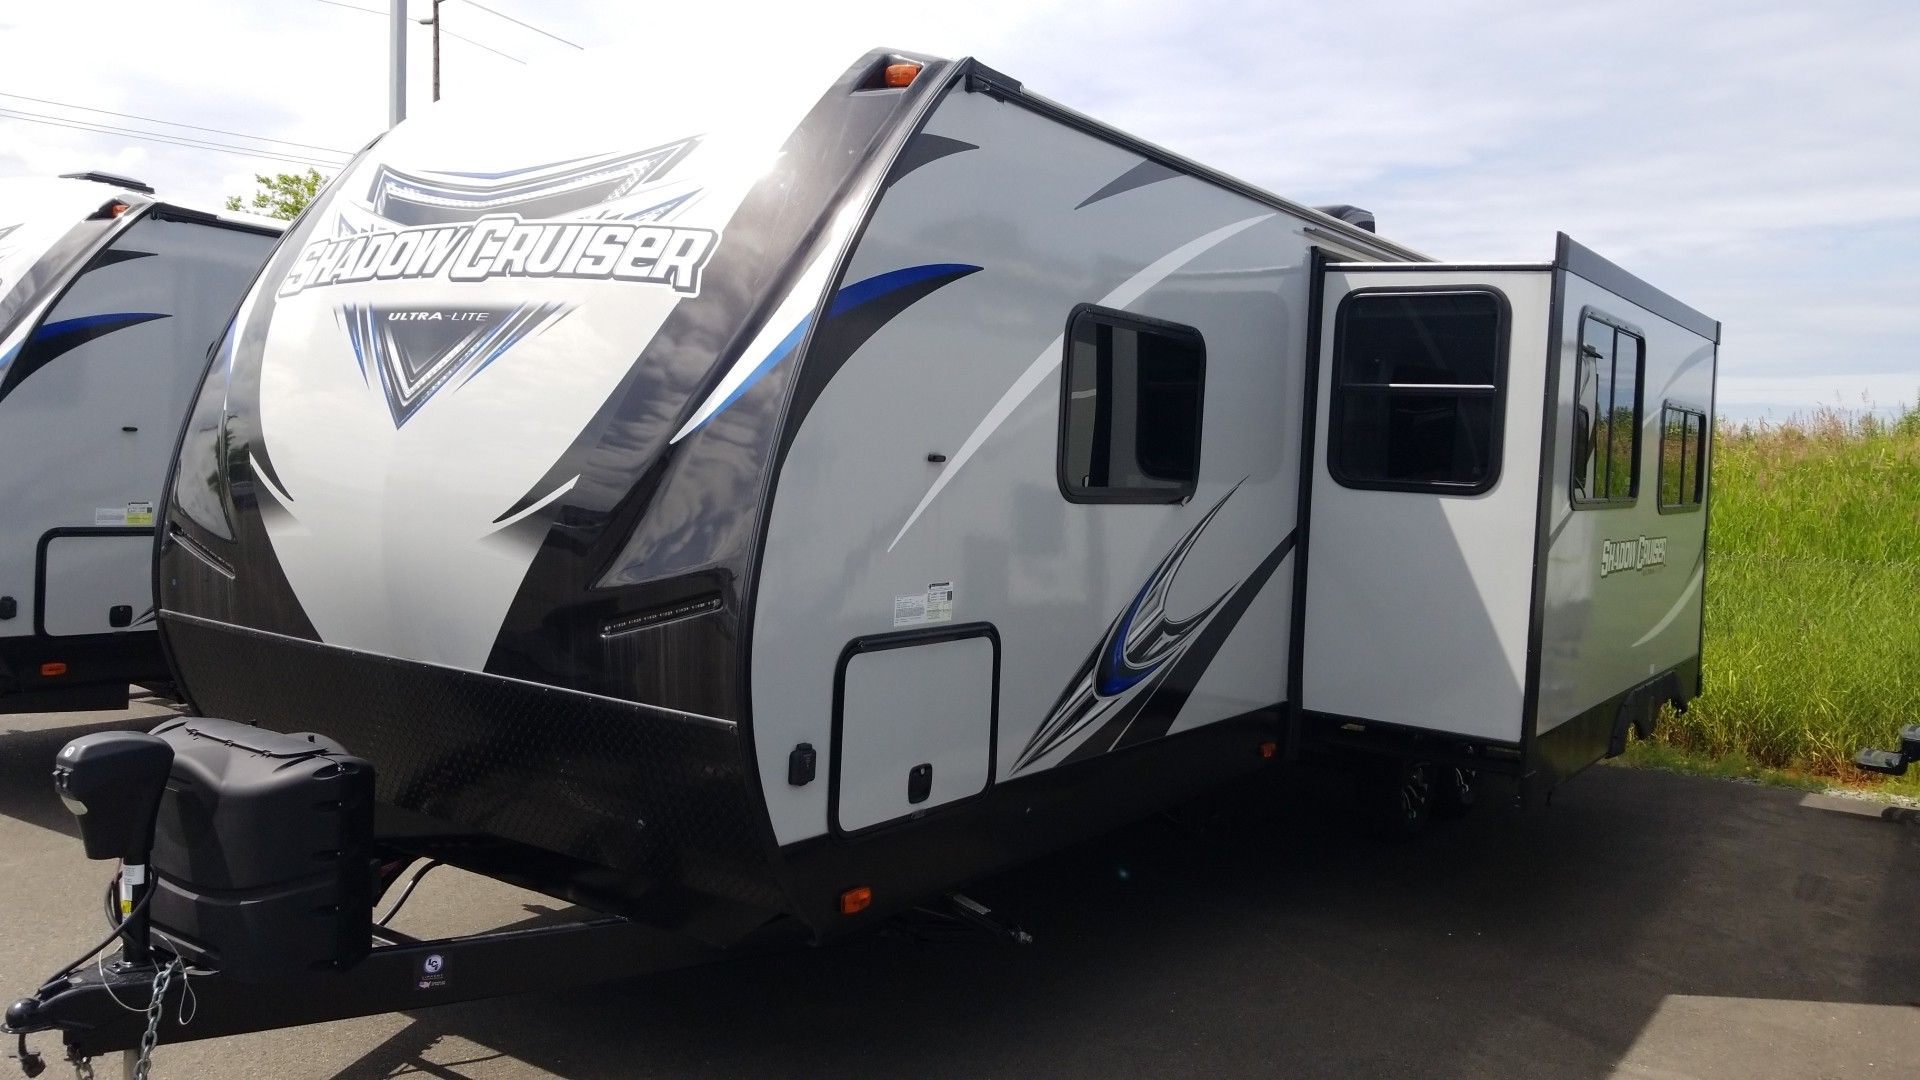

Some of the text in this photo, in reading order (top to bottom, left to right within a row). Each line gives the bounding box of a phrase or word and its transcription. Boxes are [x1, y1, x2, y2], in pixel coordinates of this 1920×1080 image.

[282, 215, 716, 297] SHADOW CRUISER
[388, 311, 489, 322] ULTRA-LITE
[1601, 539, 1638, 578] SHADOW
